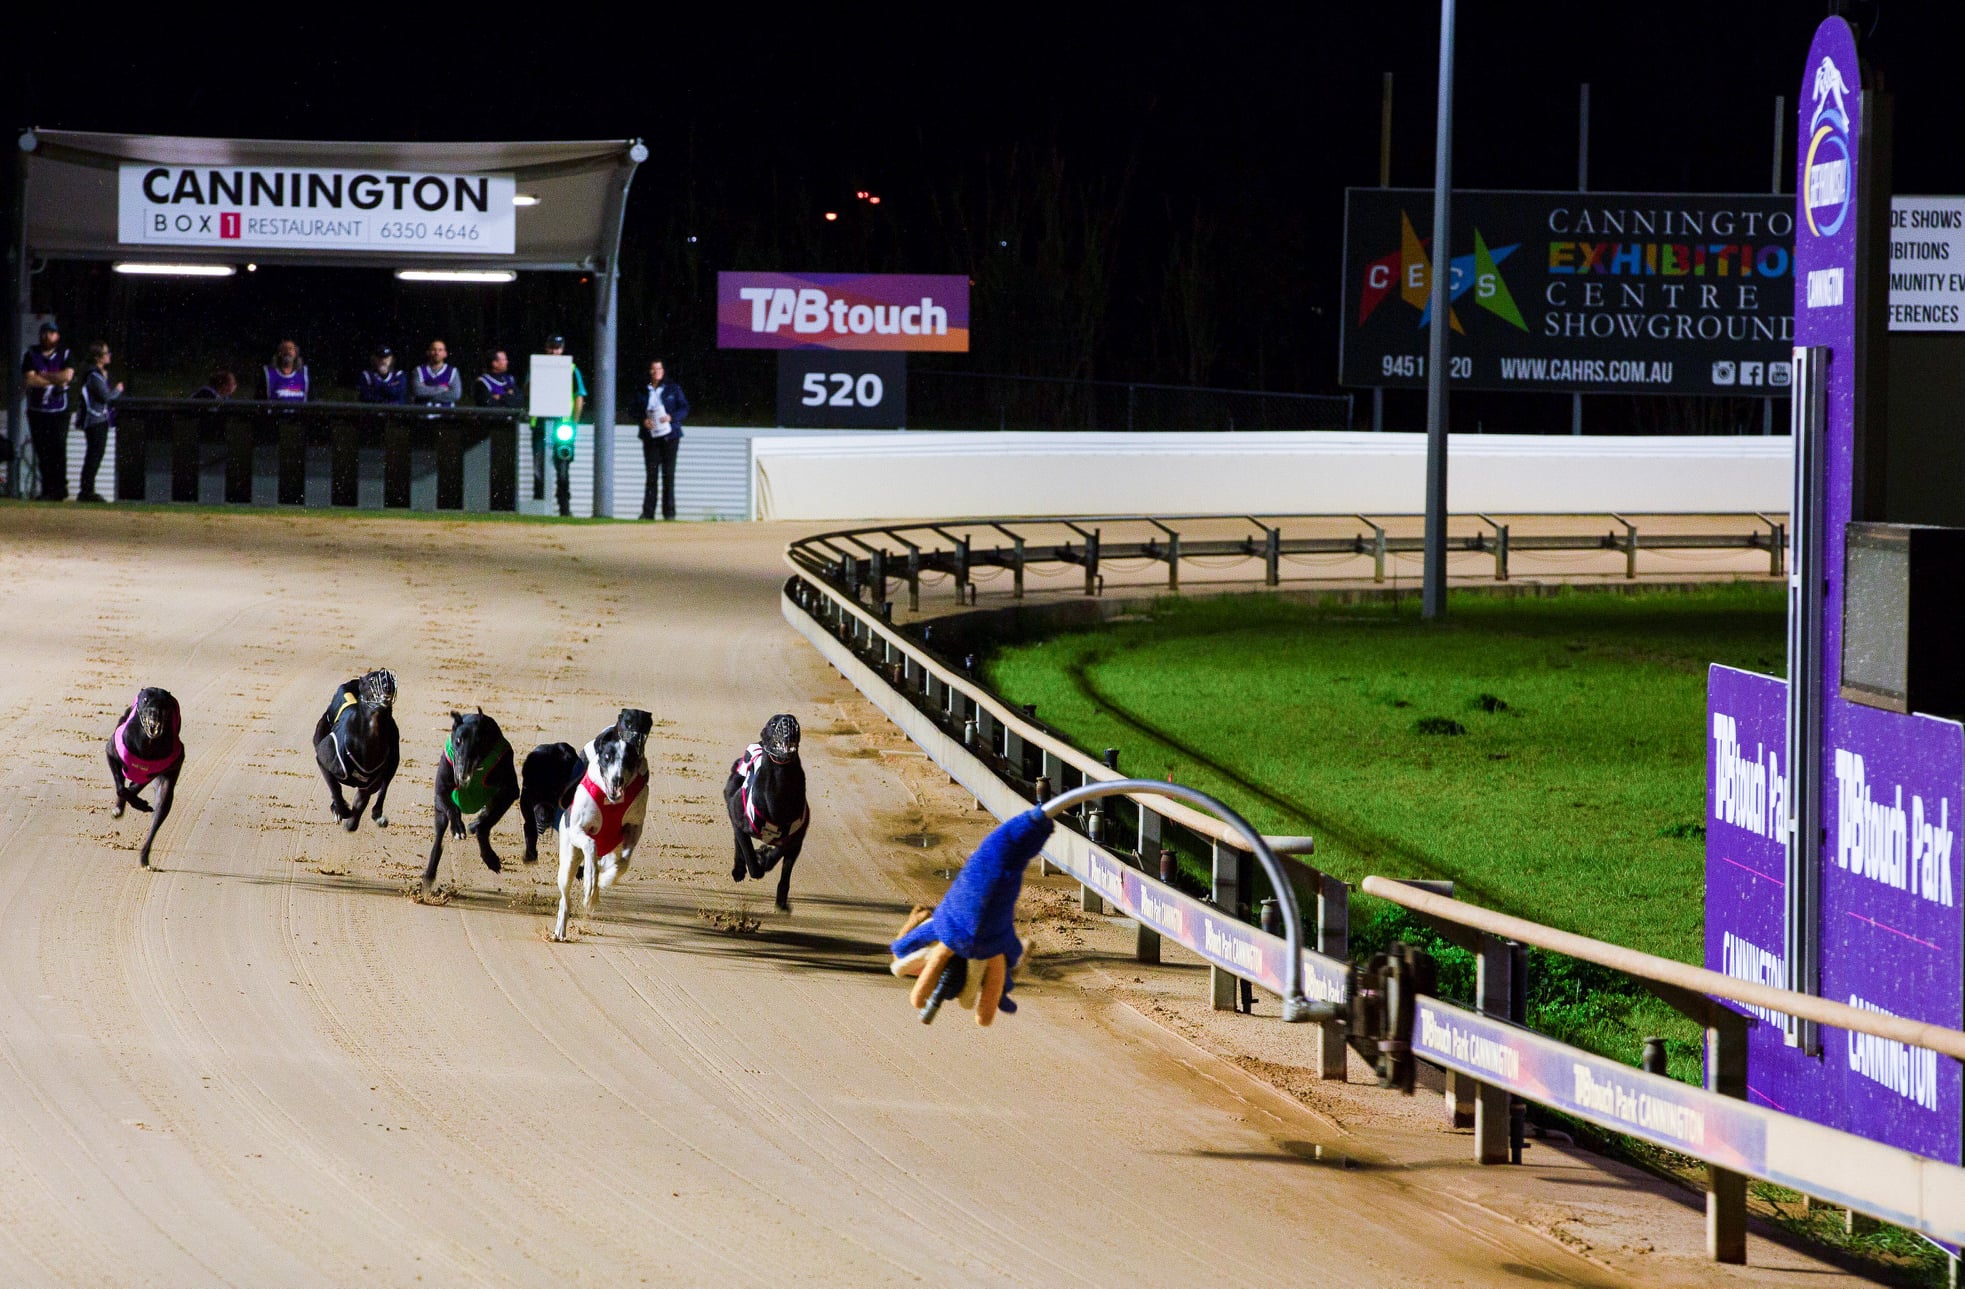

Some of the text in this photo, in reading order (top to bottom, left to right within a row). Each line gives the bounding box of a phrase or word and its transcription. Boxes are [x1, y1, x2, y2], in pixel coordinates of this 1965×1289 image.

[143, 168, 488, 212] CANNINGTON
[154, 213, 212, 233] BOX
[248, 218, 363, 237] RESTAURANT
[380, 222, 427, 239] 6350
[433, 223, 480, 241] 4646
[1548, 208, 1793, 237] CANNINGTO
[1890, 209, 1962, 229] DE SHOWS
[1548, 241, 1793, 277] EXHIBITIO
[1889, 241, 1950, 260] IBITIONS
[1546, 281, 1759, 310] CENTRE
[1889, 273, 1965, 292] MUNITY EV
[740, 287, 948, 336] TABtouch
[1888, 304, 1959, 323] FERENCES
[1382, 355, 1473, 378] 9451 20
[1500, 357, 1673, 384] WWW.CAHRS.COM.AU
[802, 372, 884, 407] 520
[1713, 712, 1766, 837] TABtouch
[1835, 748, 1954, 908] TABtouch Park
